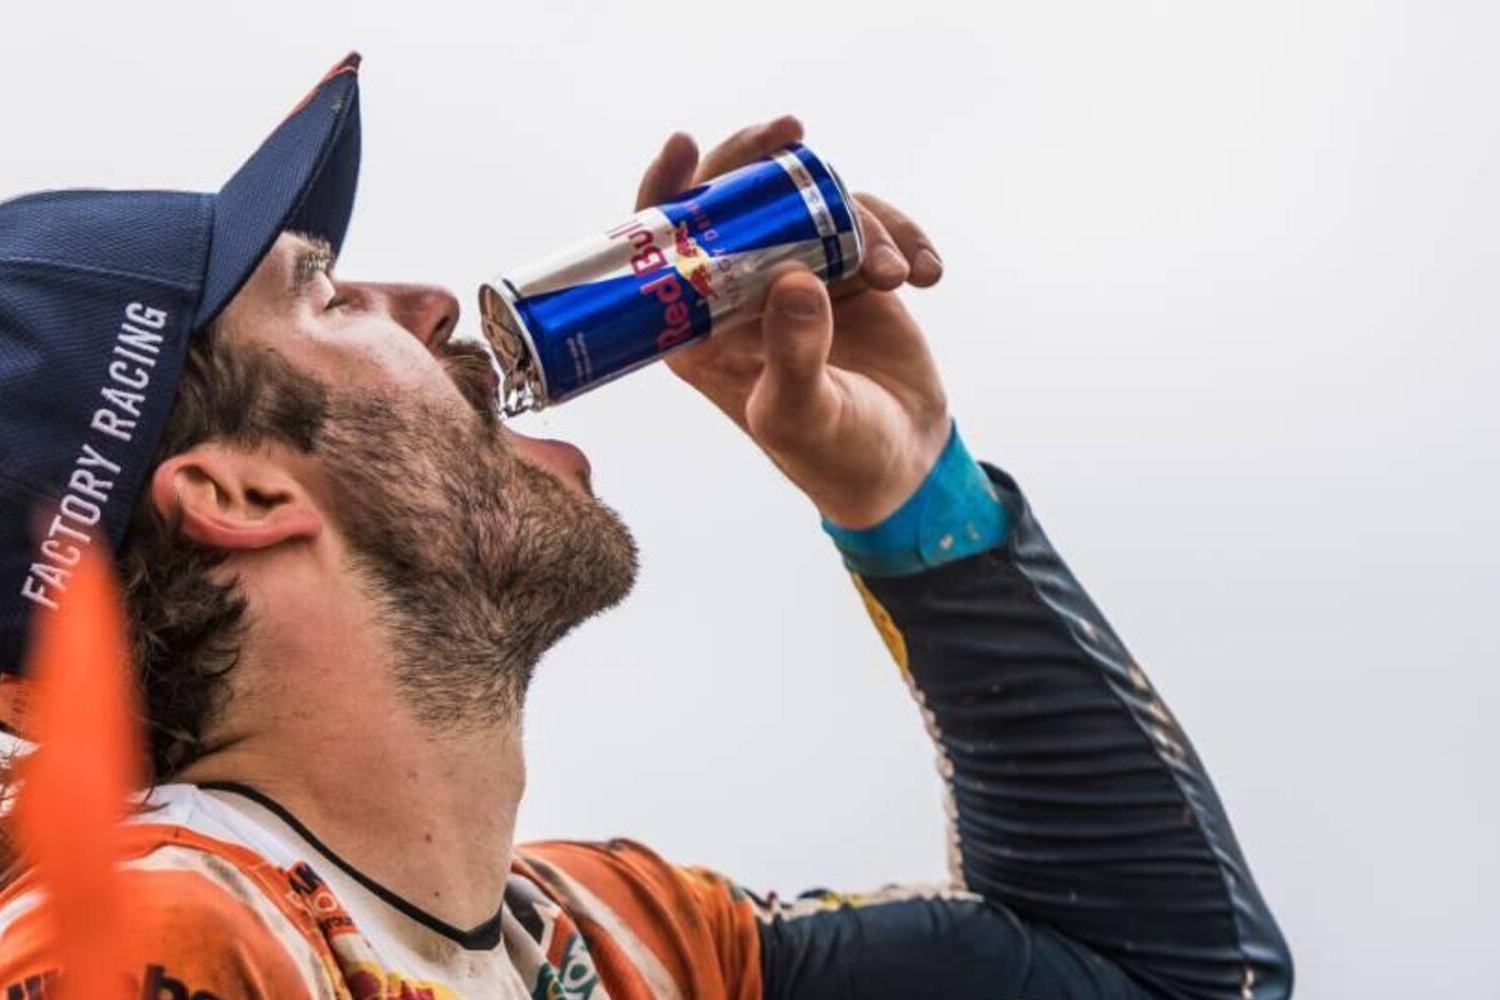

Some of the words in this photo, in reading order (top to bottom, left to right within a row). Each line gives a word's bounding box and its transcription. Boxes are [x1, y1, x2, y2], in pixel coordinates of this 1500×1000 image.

[609, 217, 667, 278] Bull
[639, 274, 694, 351] Red
[21, 445, 122, 610] FACTORY
[90, 301, 168, 443] RACING
